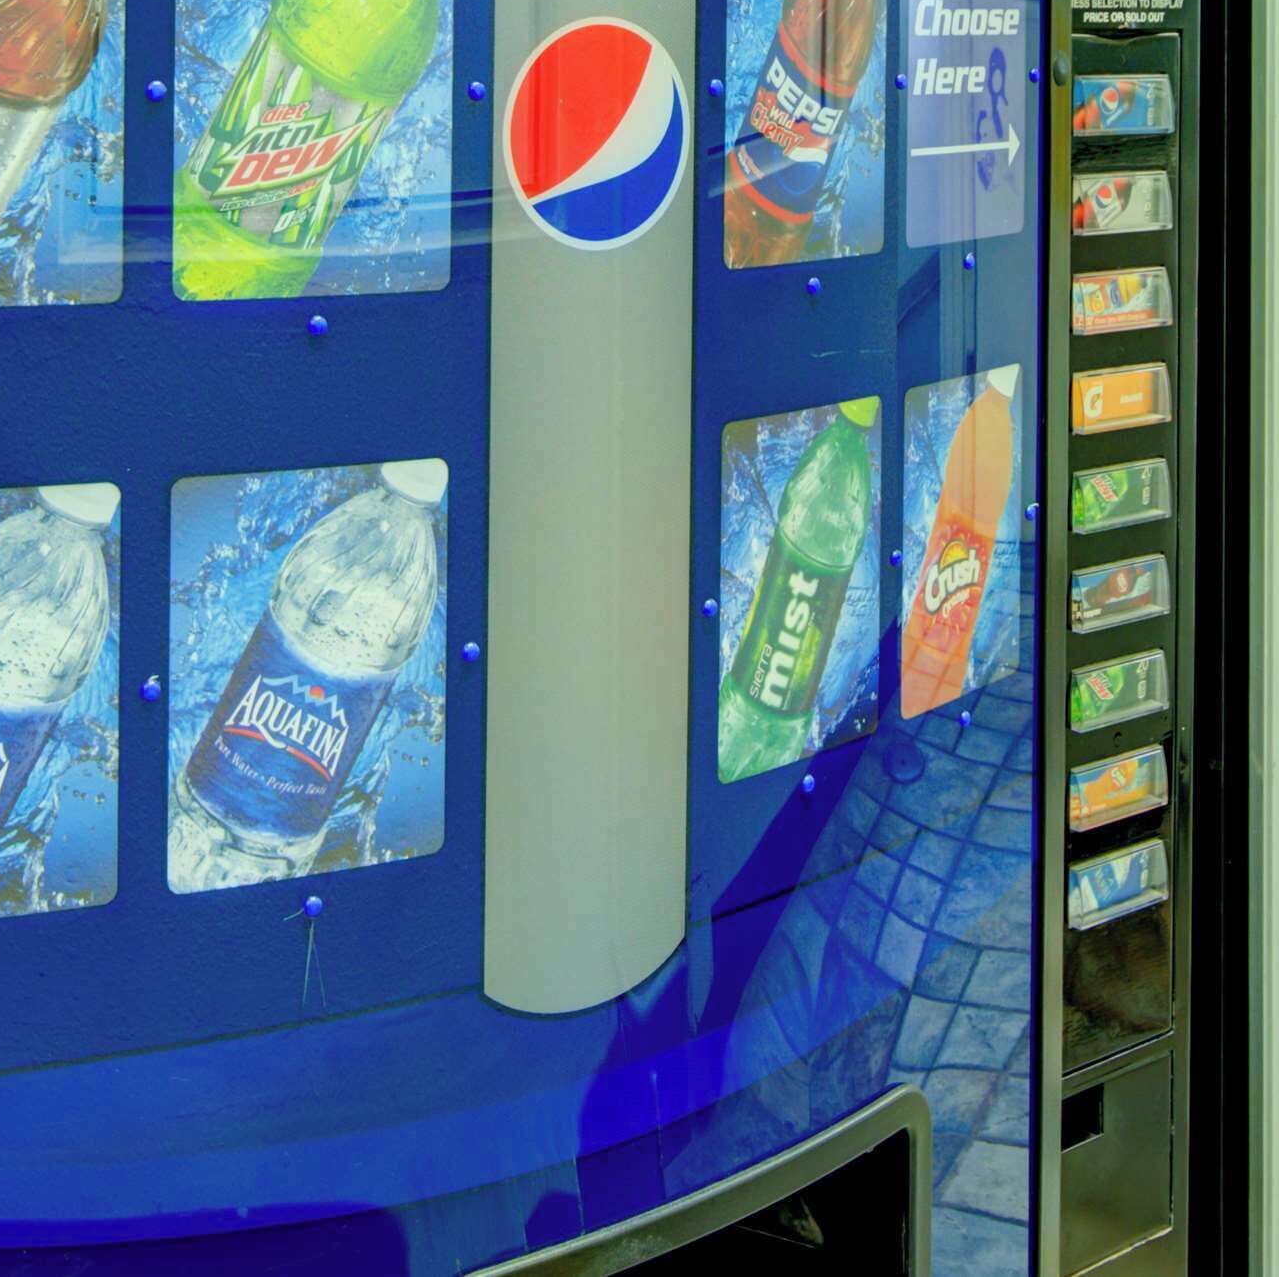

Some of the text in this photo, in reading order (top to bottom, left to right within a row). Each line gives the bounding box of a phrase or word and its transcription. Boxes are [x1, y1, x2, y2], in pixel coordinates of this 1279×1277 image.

[1083, 11, 1166, 23] PRICE OR SOLD OUT
[766, 55, 844, 135] PEPSI
[912, 57, 987, 96] Here
[263, 101, 310, 123] diet
[751, 102, 806, 156] Cherry
[925, 548, 982, 614] Crush
[759, 571, 820, 709] mist
[224, 673, 349, 778] AQUAFINA
[232, 752, 259, 780] Water
[266, 776, 304, 795] Perfect
